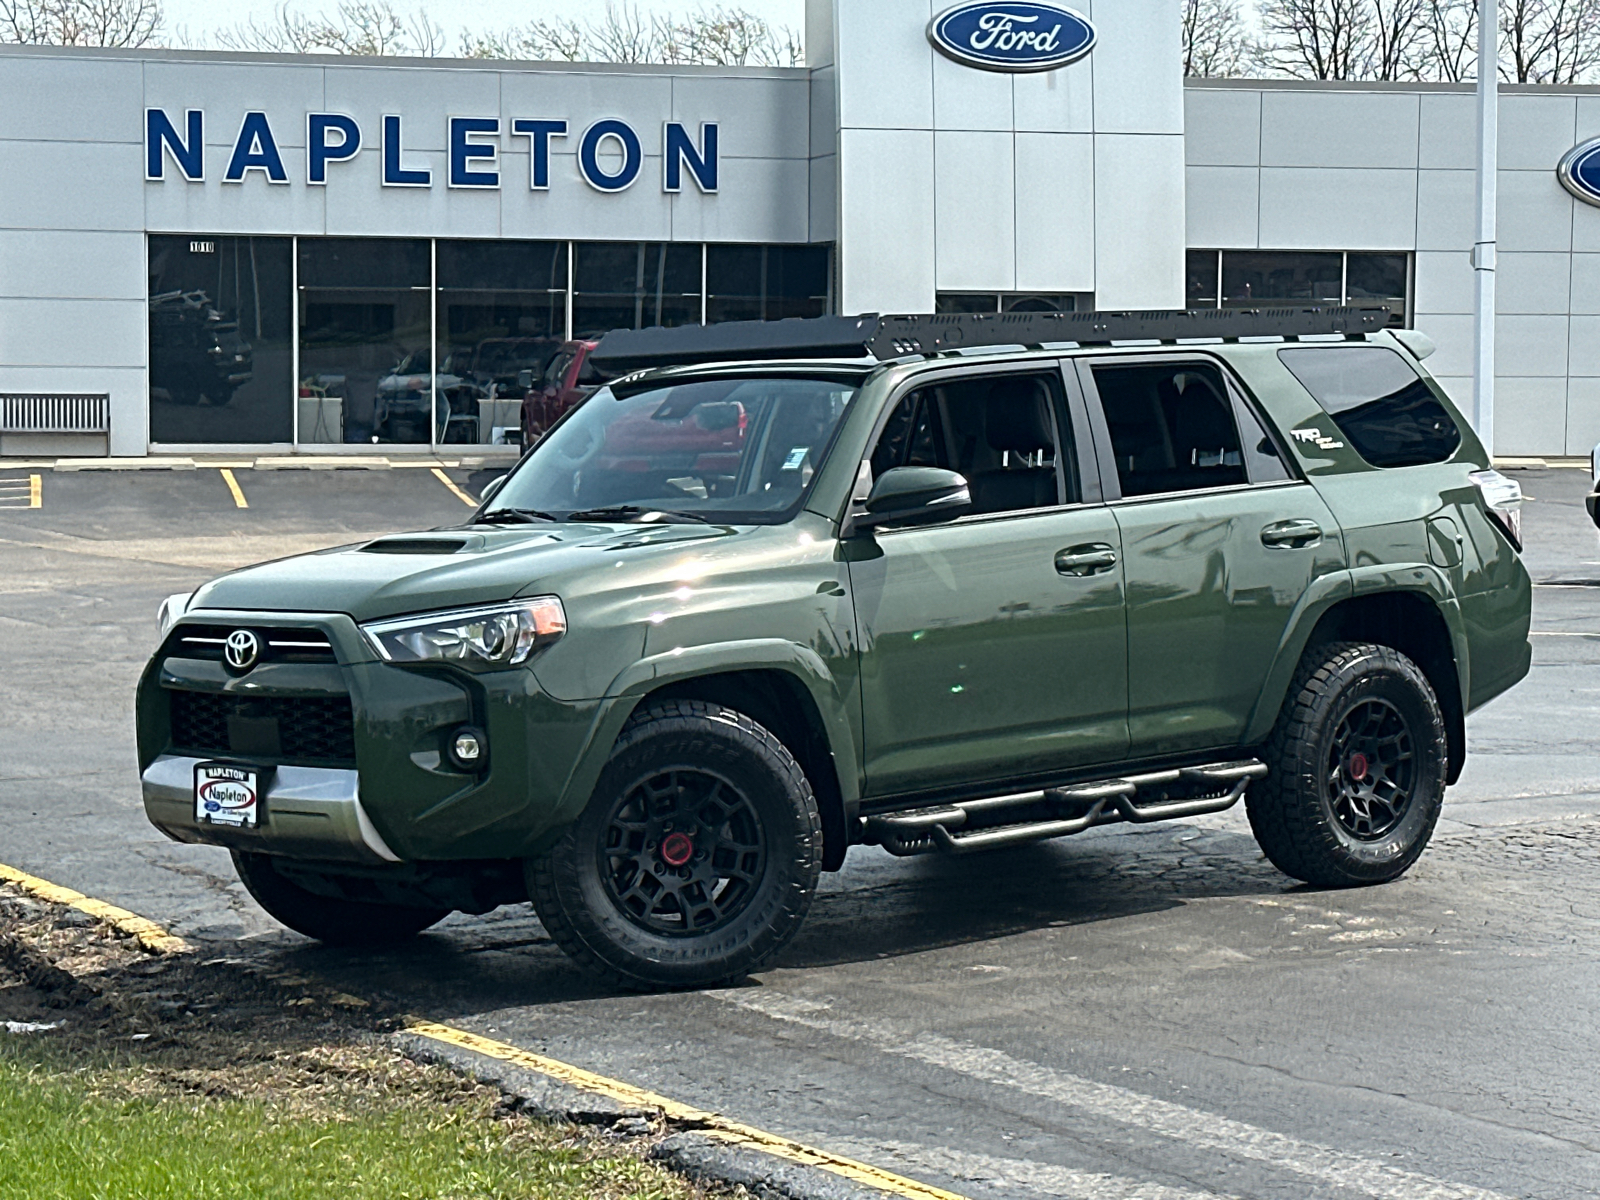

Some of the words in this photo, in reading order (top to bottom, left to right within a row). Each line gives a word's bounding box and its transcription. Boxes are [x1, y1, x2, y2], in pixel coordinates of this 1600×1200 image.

[970, 12, 1062, 52] Ford
[144, 107, 719, 194] NAPLETON
[190, 241, 215, 253] 1010
[1290, 428, 1320, 443] TRD
[208, 768, 245, 780] NAPLETON
[208, 786, 247, 804] Napleton
